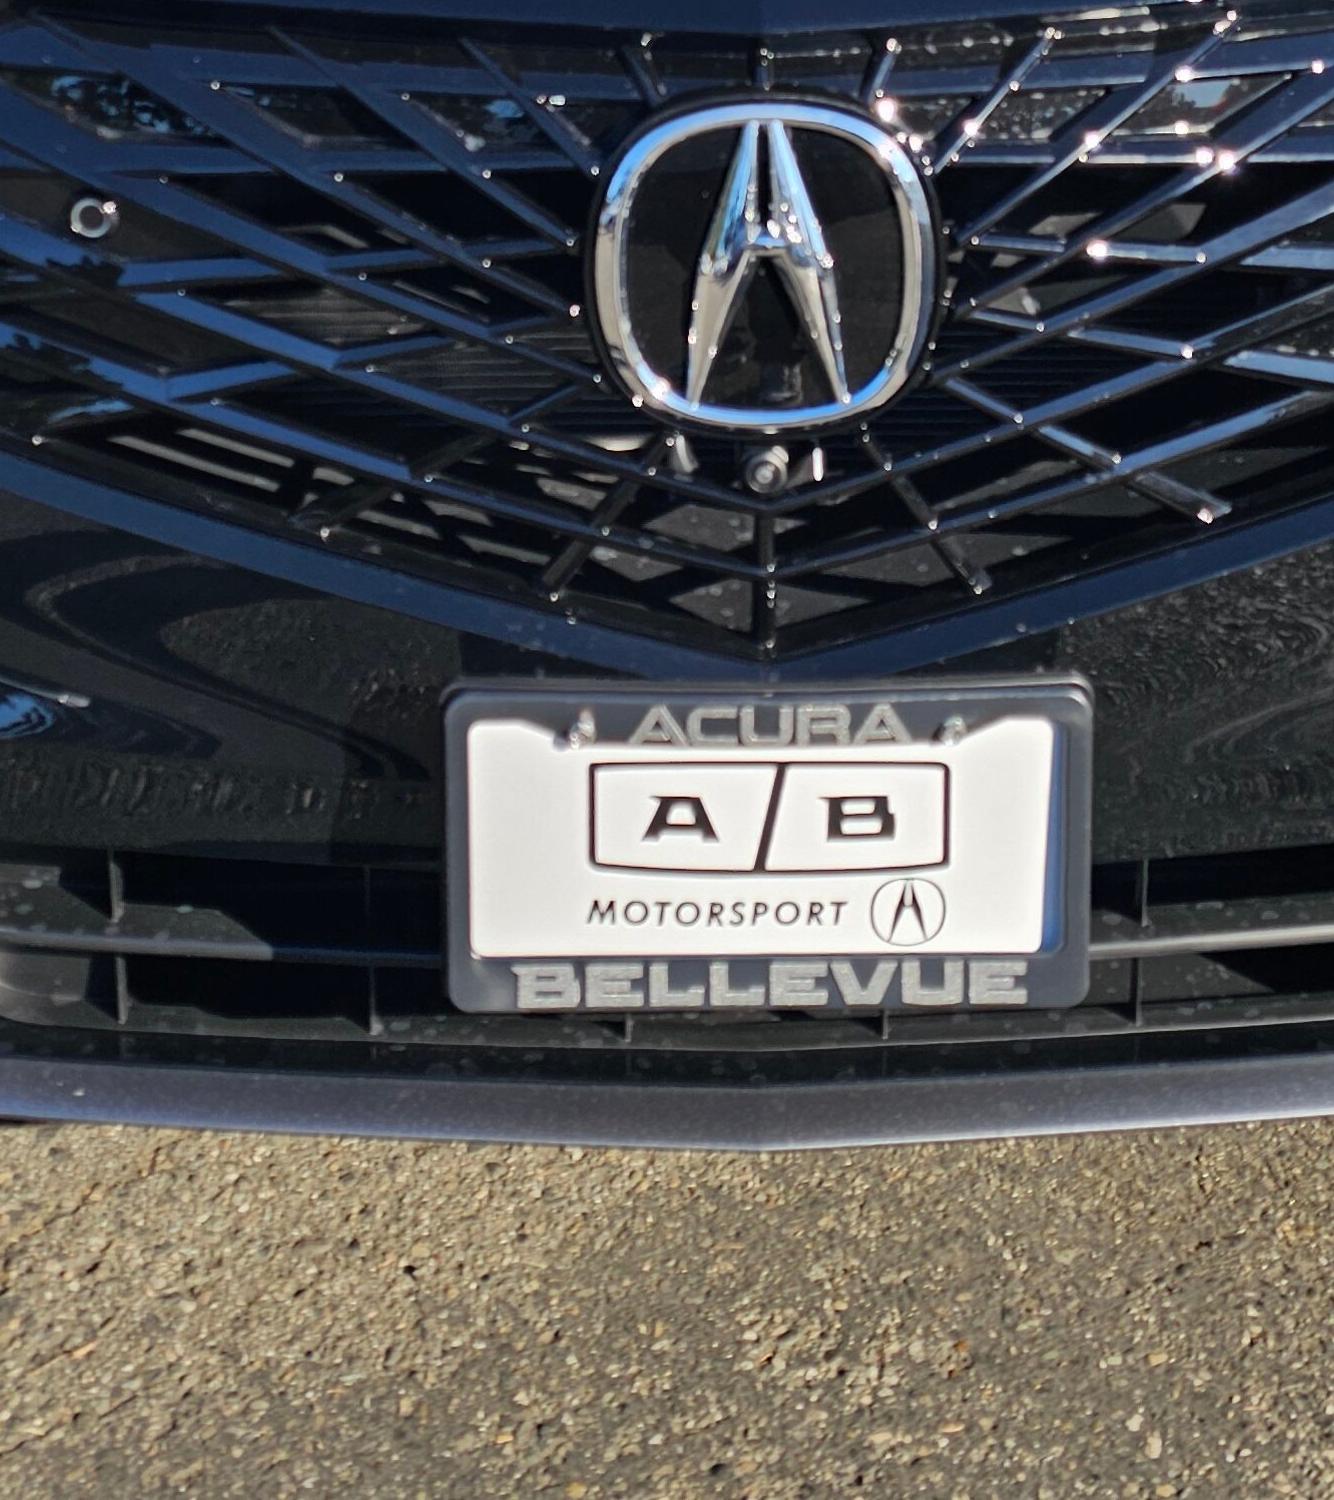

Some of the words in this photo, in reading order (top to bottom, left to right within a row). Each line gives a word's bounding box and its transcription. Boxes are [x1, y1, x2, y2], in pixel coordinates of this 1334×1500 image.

[630, 704, 911, 747] ACURA
[586, 900, 848, 927] MOTORSPORT
[510, 959, 1028, 1009] BELLEVUE
